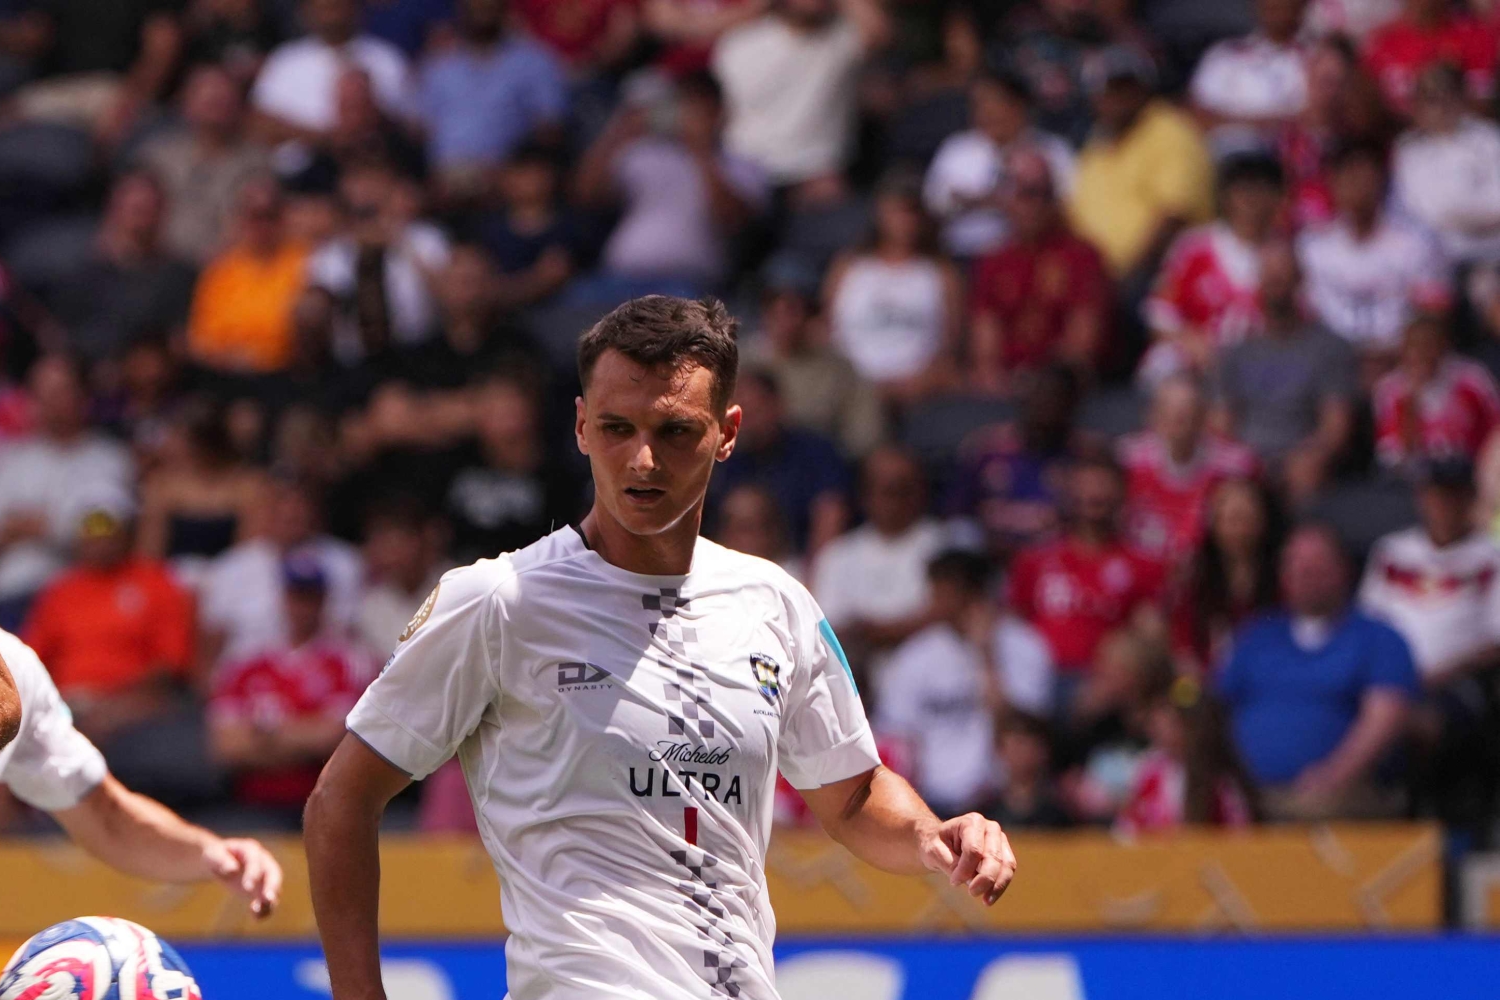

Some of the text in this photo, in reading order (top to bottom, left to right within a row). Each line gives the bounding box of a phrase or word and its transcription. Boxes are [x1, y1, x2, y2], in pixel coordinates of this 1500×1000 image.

[558, 683, 613, 693] DYNASTY
[648, 740, 734, 765] Michelob
[629, 767, 742, 805] ULTRA
